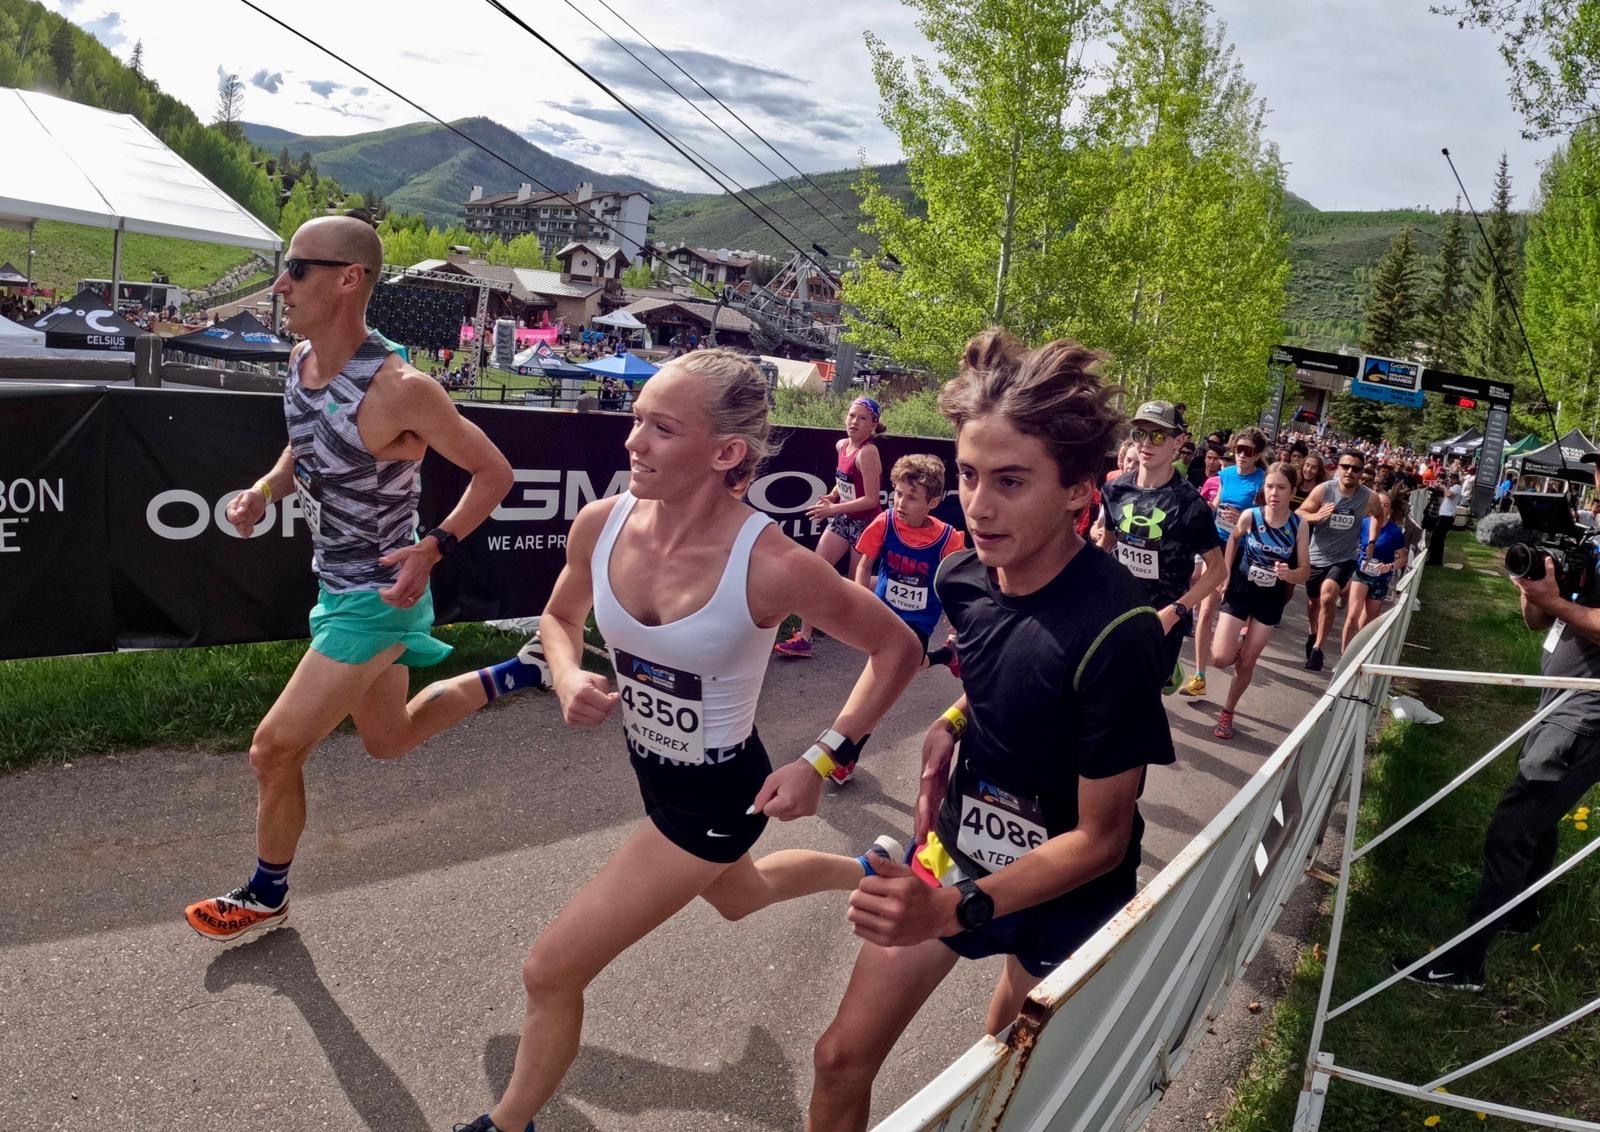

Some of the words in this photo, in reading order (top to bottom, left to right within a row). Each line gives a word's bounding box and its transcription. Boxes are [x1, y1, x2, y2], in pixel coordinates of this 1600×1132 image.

[87, 335, 125, 346] CELSIUS
[1390, 362, 1417, 371] GoPro
[1332, 515, 1353, 525] 4303
[488, 536, 511, 550] WE
[514, 535, 544, 549] ARE
[1122, 548, 1152, 565] 4118
[890, 585, 922, 602] 4211
[897, 600, 920, 609] TERREX
[621, 685, 699, 733] 4350
[641, 726, 690, 752] TERREX
[962, 806, 1044, 849] 4086
[988, 851, 1020, 867] TER
